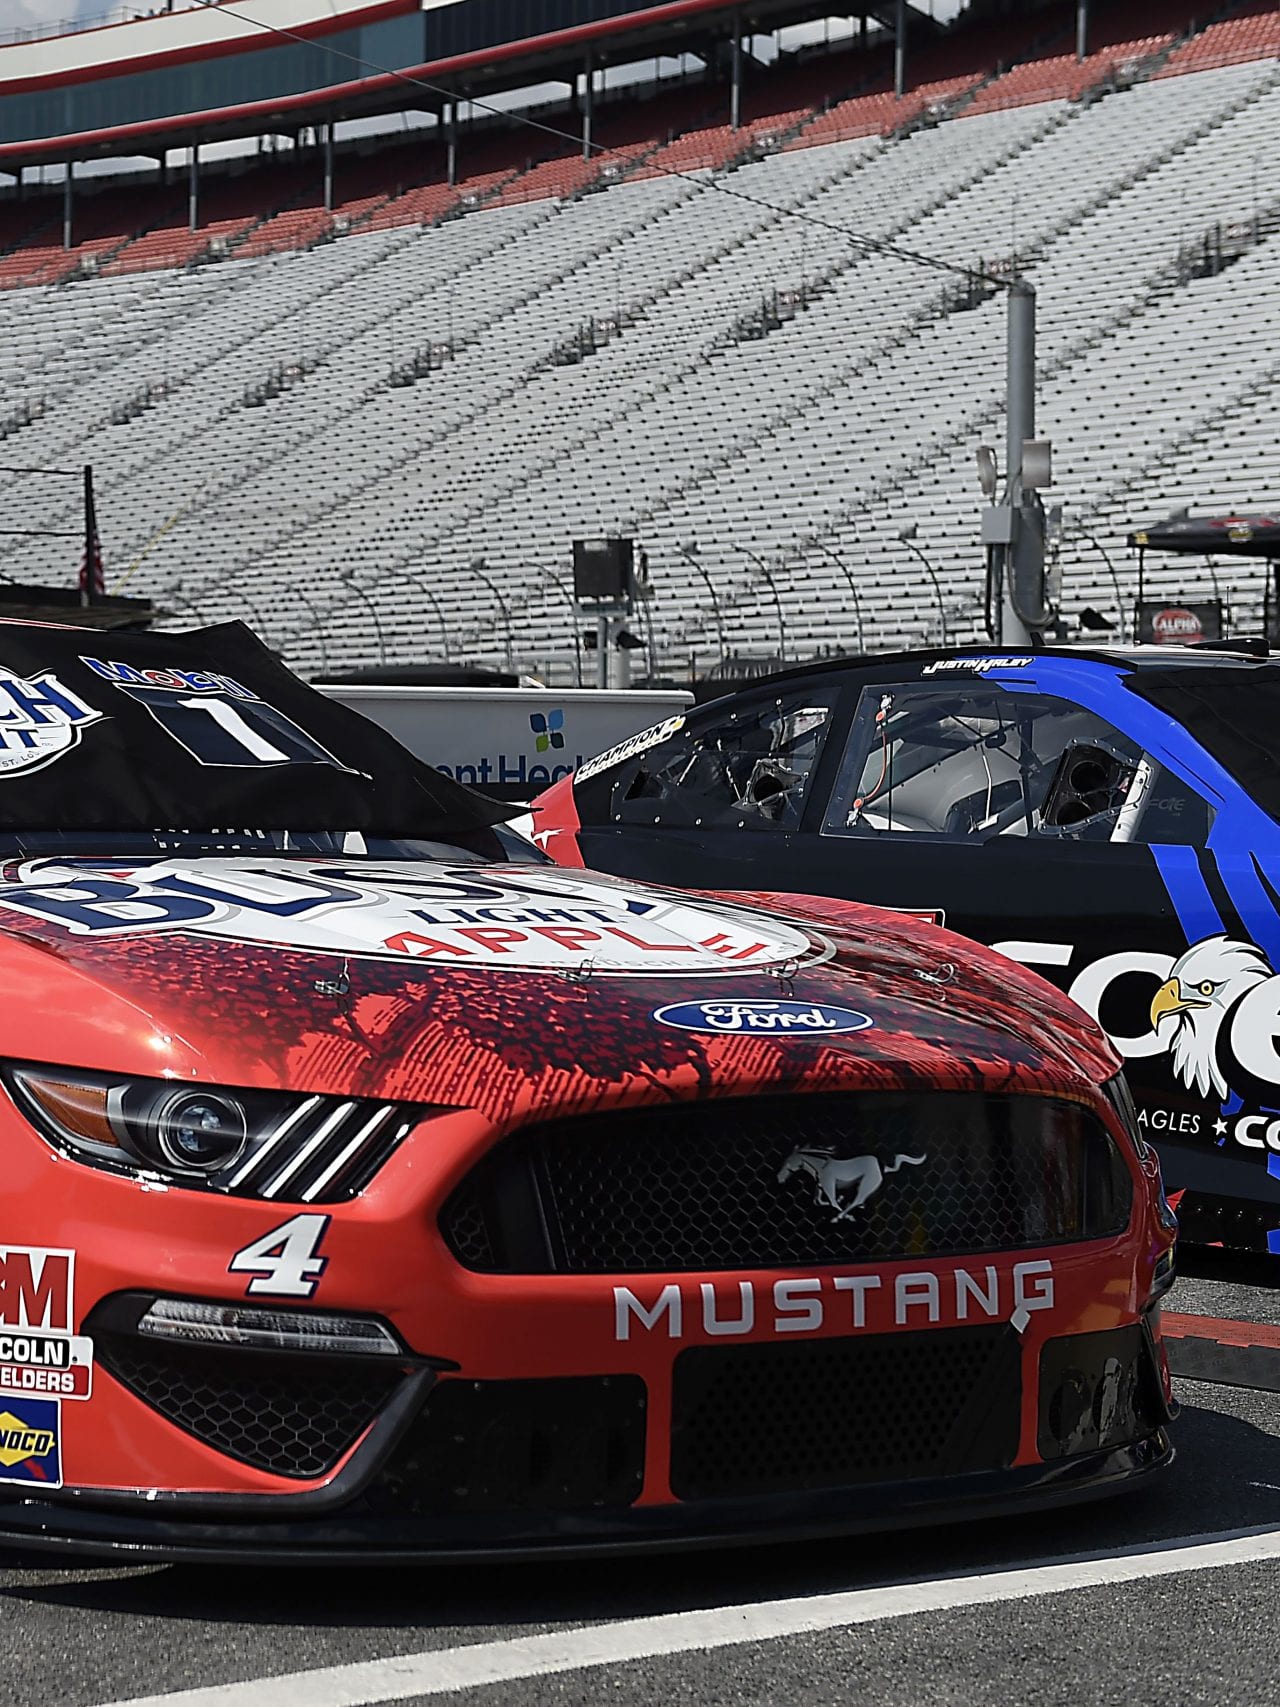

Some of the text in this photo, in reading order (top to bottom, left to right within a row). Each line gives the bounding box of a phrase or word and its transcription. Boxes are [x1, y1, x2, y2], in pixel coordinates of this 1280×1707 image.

[78, 655, 261, 700] Mobil
[923, 658, 1034, 674] JUSTIN HALEY
[177, 698, 291, 762] 1
[578, 721, 666, 775] CHAMPION
[406, 908, 617, 925] LIGHT
[382, 926, 771, 960] APPLE
[700, 1002, 837, 1029] Ford
[229, 1213, 329, 1297] 4
[613, 1259, 1055, 1341] MUSTANG
